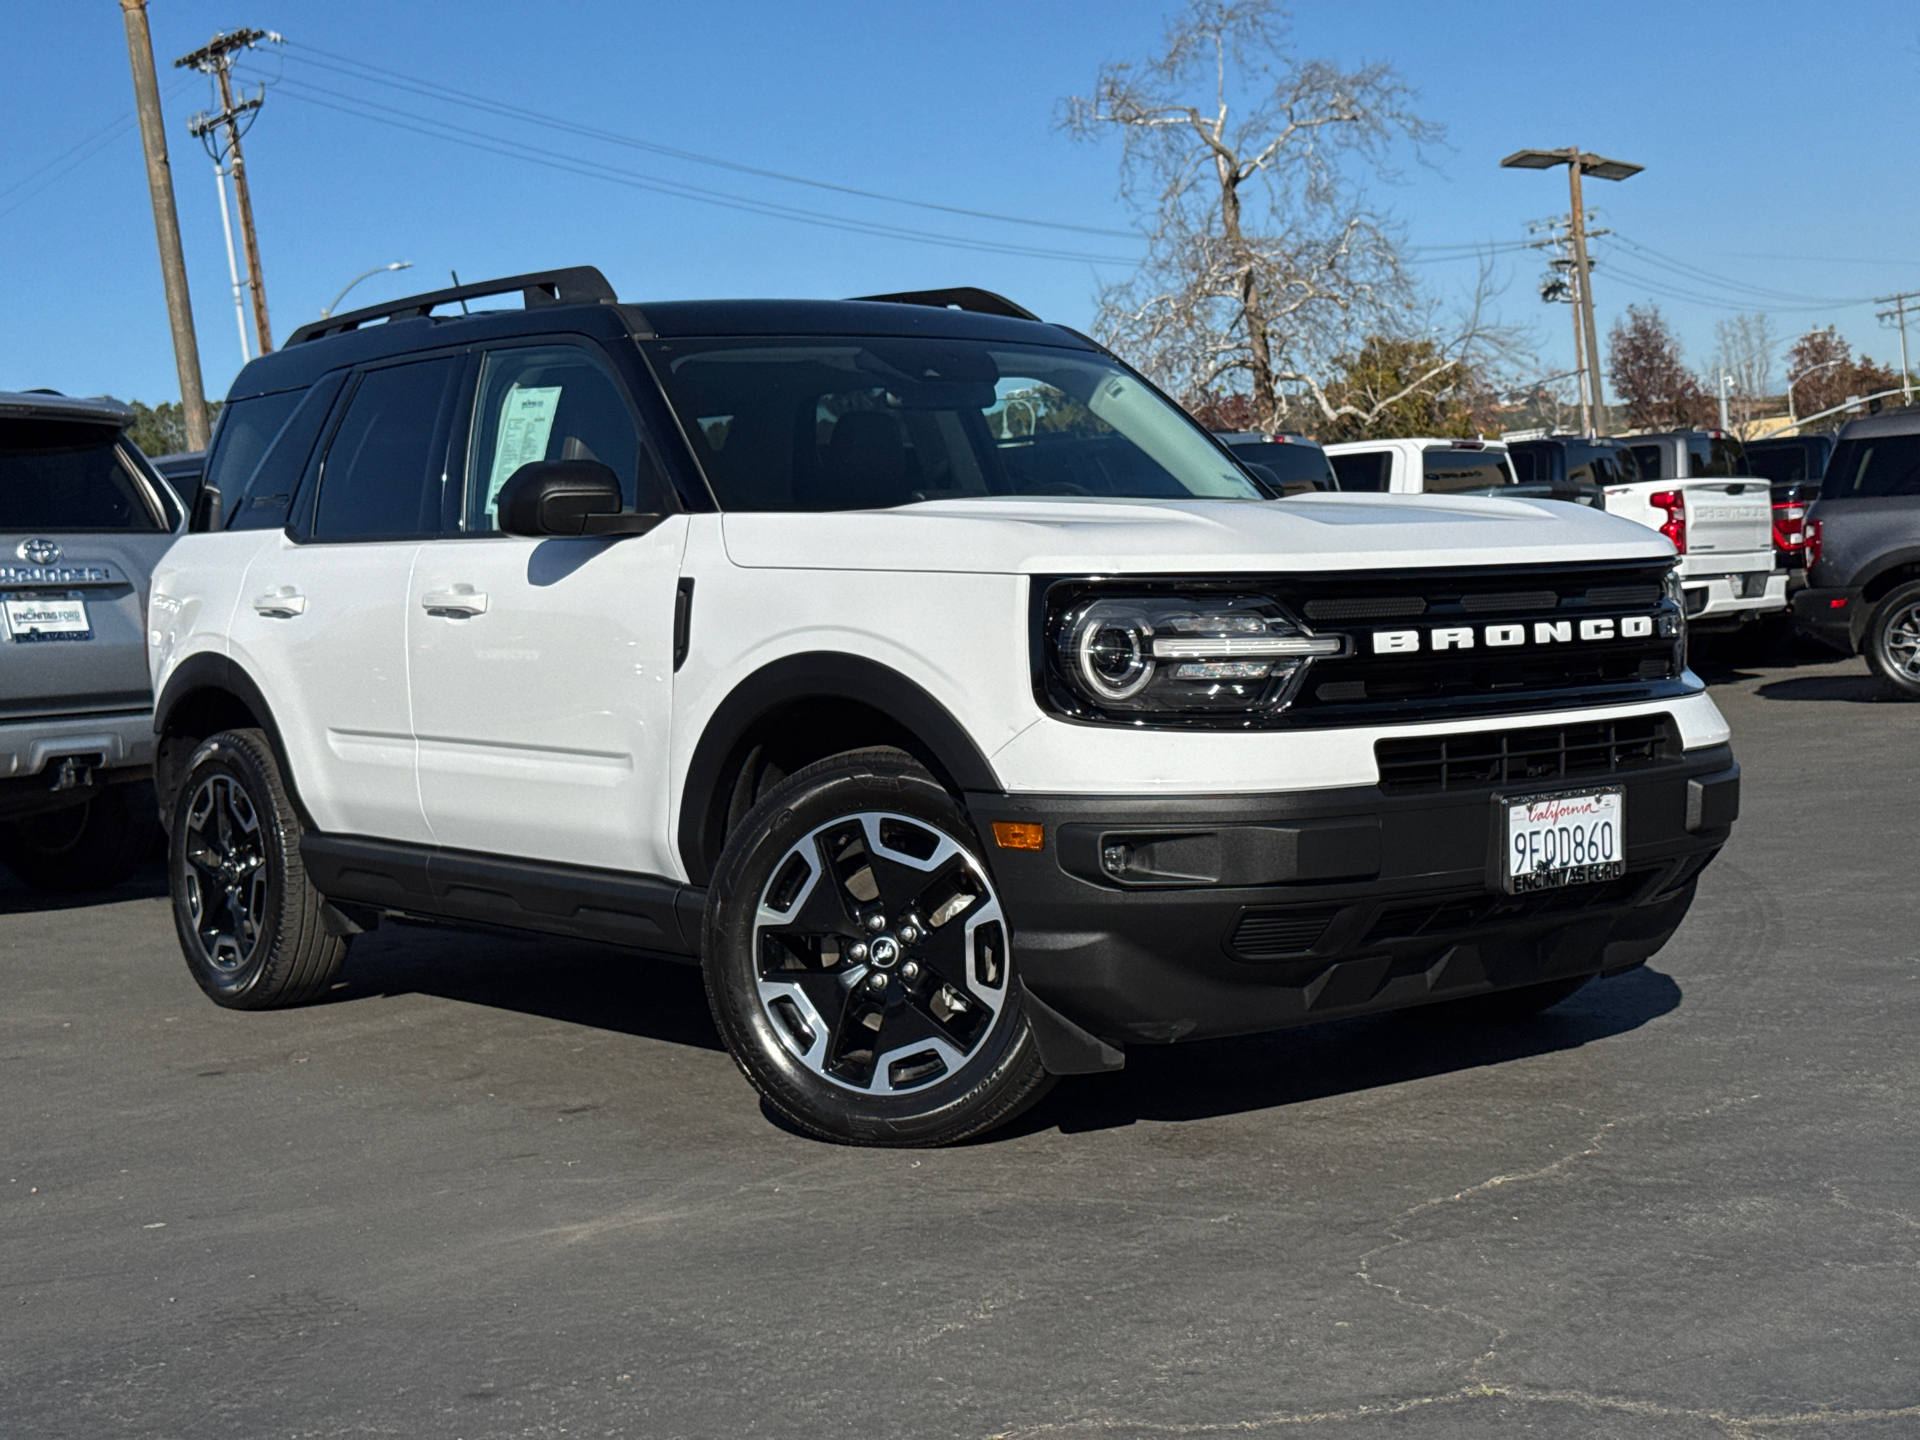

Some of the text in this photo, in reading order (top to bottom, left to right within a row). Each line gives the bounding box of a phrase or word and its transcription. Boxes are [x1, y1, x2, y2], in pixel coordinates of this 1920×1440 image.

[13, 611, 80, 621] ENCINITAS FORD
[1373, 616, 1652, 654] BRONCO
[1528, 800, 1600, 825] California
[1513, 863, 1621, 892] ENCINITAS FORD
